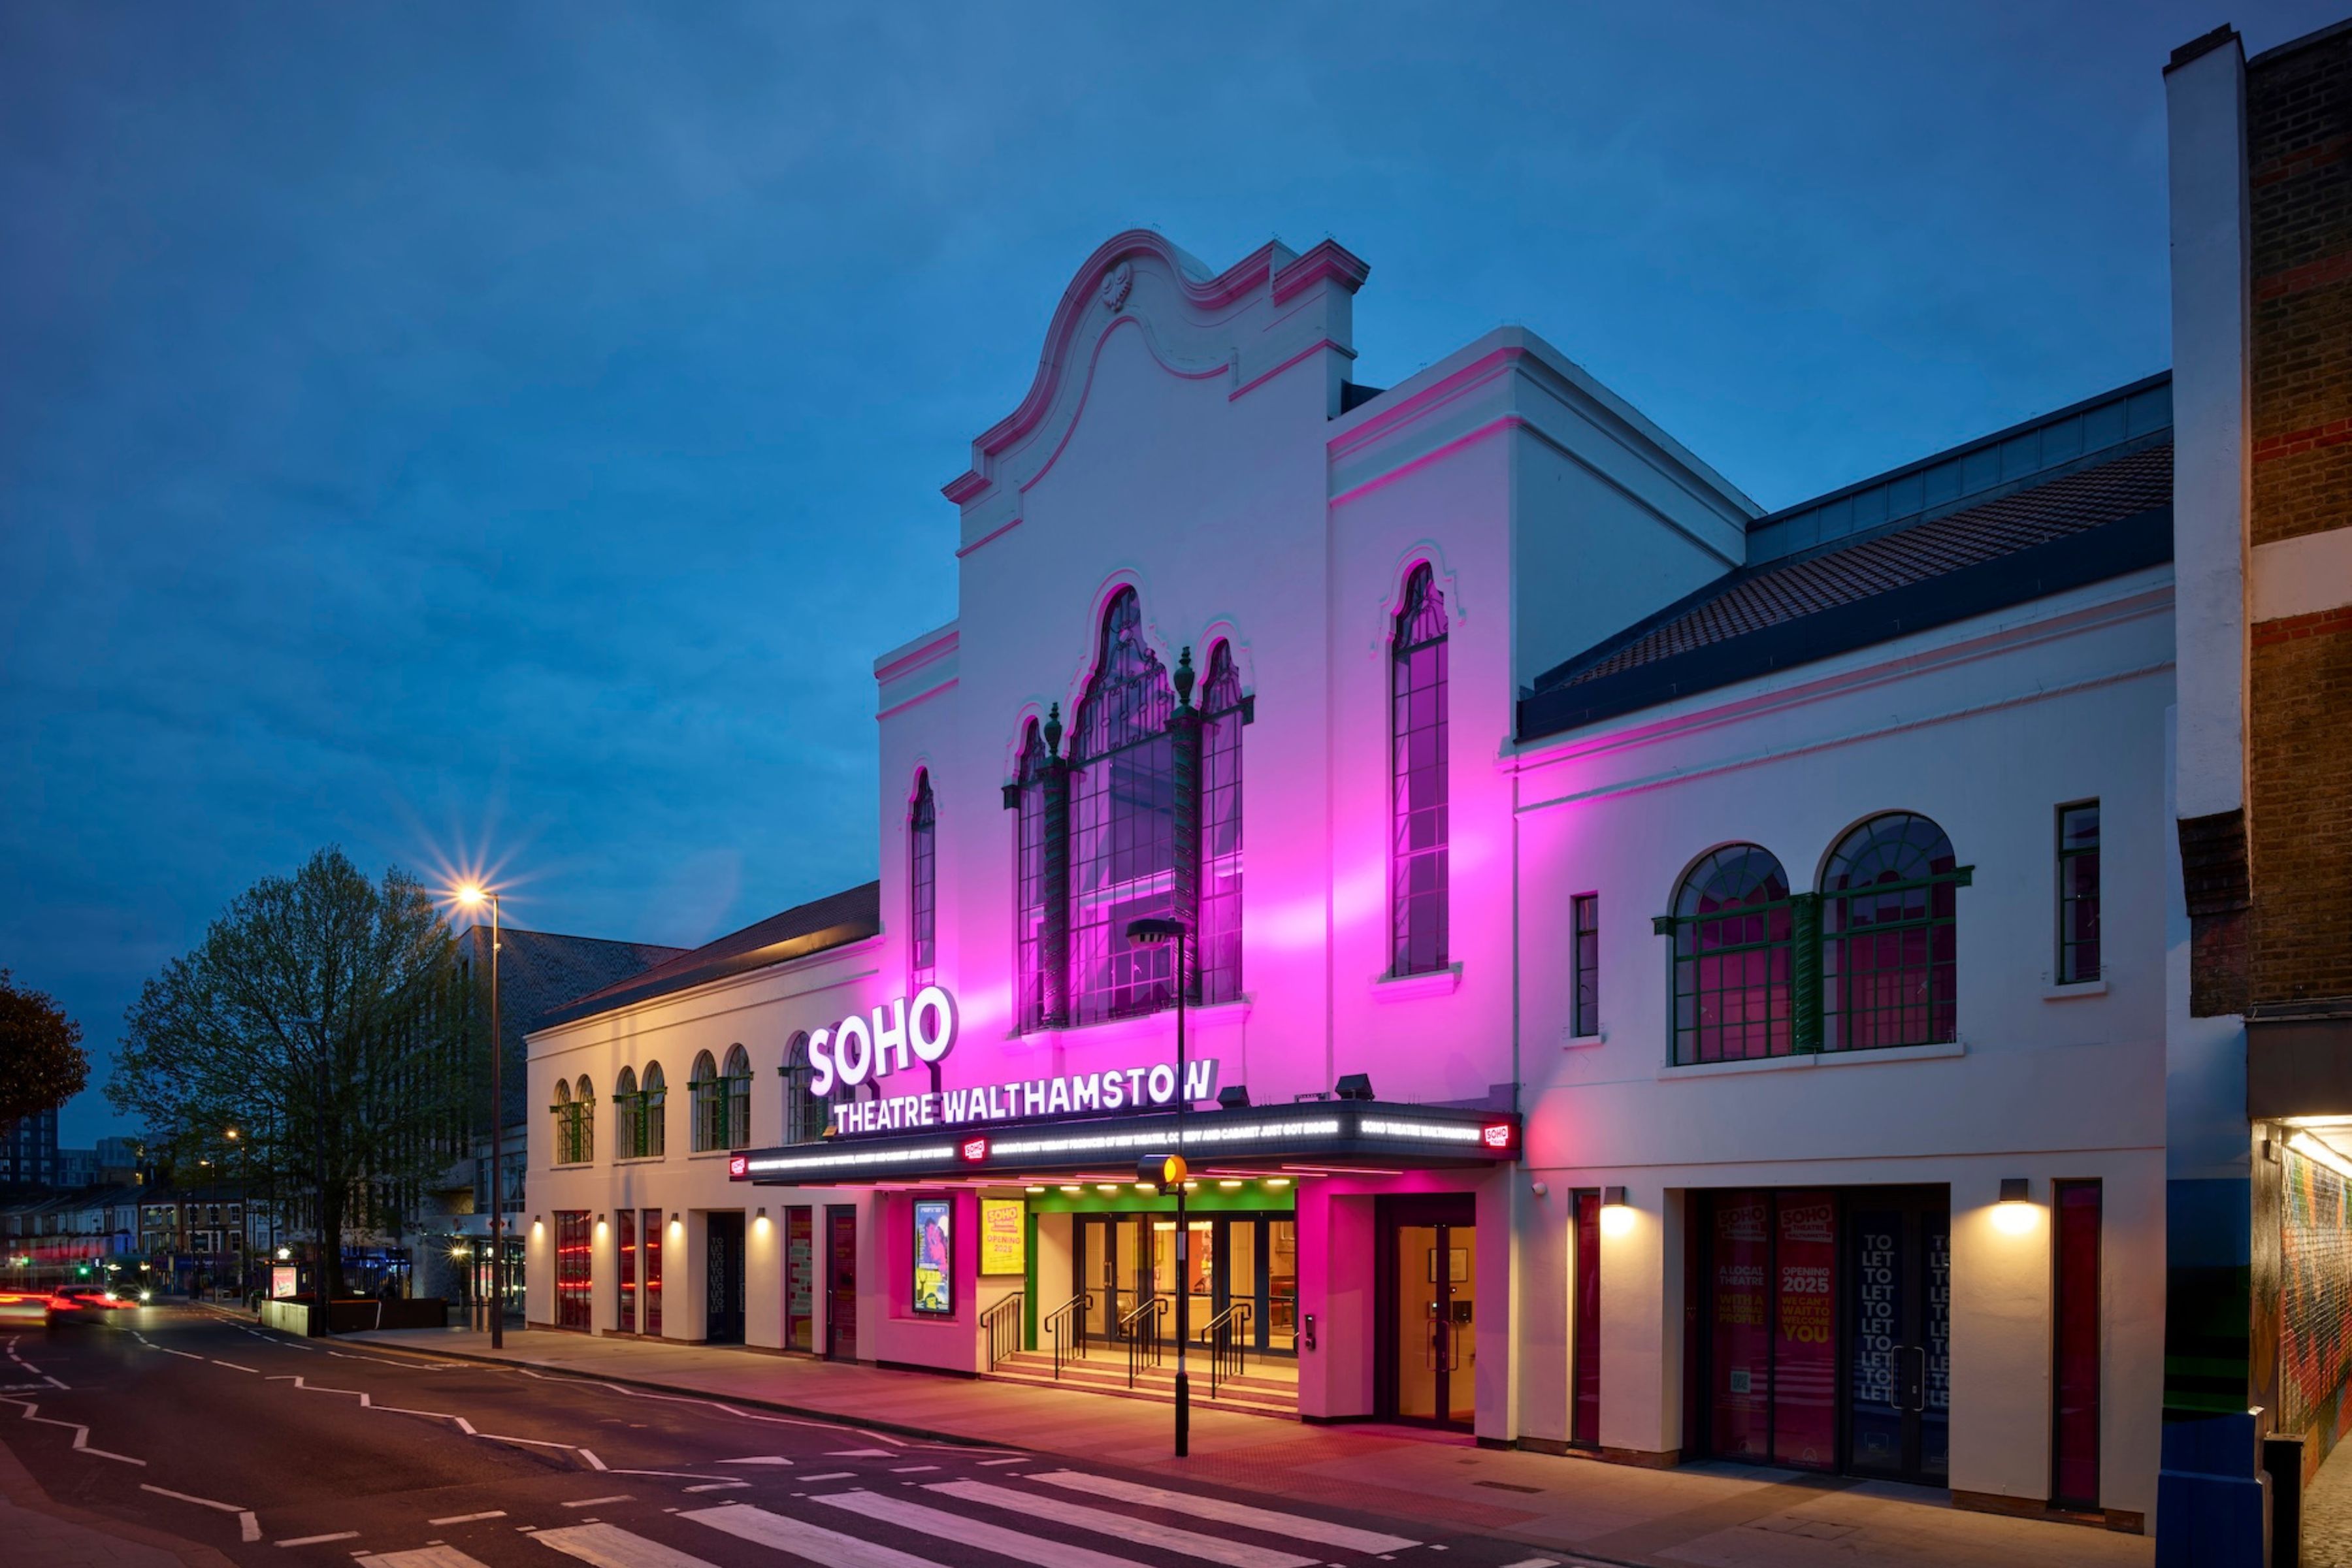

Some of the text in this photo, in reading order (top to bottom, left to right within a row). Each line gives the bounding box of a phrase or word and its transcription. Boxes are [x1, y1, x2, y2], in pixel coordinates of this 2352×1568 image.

[808, 985, 956, 1096] SOHO
[834, 1059, 1214, 1134] THEATRE WALTHAMSTOW
[1261, 1125, 1282, 1136] JUST
[1283, 1124, 1303, 1135] GOT
[1362, 1121, 1385, 1133] SOHO
[1486, 1127, 1507, 1140] SOHO
[988, 1208, 1017, 1222] SOHO
[1720, 1207, 1763, 1225] SOHO
[1782, 1207, 1829, 1225] SOHO
[987, 1235, 1021, 1245] OPENING
[1864, 1235, 1892, 1250] TO
[1862, 1251, 1895, 1267] LET
[1930, 1252, 1949, 1267] LE
[1719, 1266, 1764, 1276] A LOCAL
[1782, 1266, 1830, 1276] OPENING
[1864, 1267, 1892, 1283] TO
[1720, 1276, 1764, 1286] THEATRE
[1782, 1276, 1829, 1294] 2025
[1719, 1294, 1763, 1306] WITH A
[1862, 1284, 1895, 1300] LET
[1930, 1286, 1949, 1302] LE
[1782, 1296, 1830, 1306] WE CAN'T
[1863, 1301, 1892, 1317] TO
[1782, 1306, 1830, 1316] WAIT TO
[1782, 1316, 1830, 1326] WELCOME
[1862, 1317, 1895, 1333] LET
[1930, 1320, 1949, 1337] LE
[1783, 1325, 1829, 1343] YOU
[1863, 1334, 1892, 1350] TO
[1861, 1350, 1892, 1367] LET
[1930, 1354, 1949, 1371] LE
[1863, 1367, 1892, 1384] TO
[1861, 1384, 1892, 1401] LET
[1930, 1389, 1949, 1405] LE
